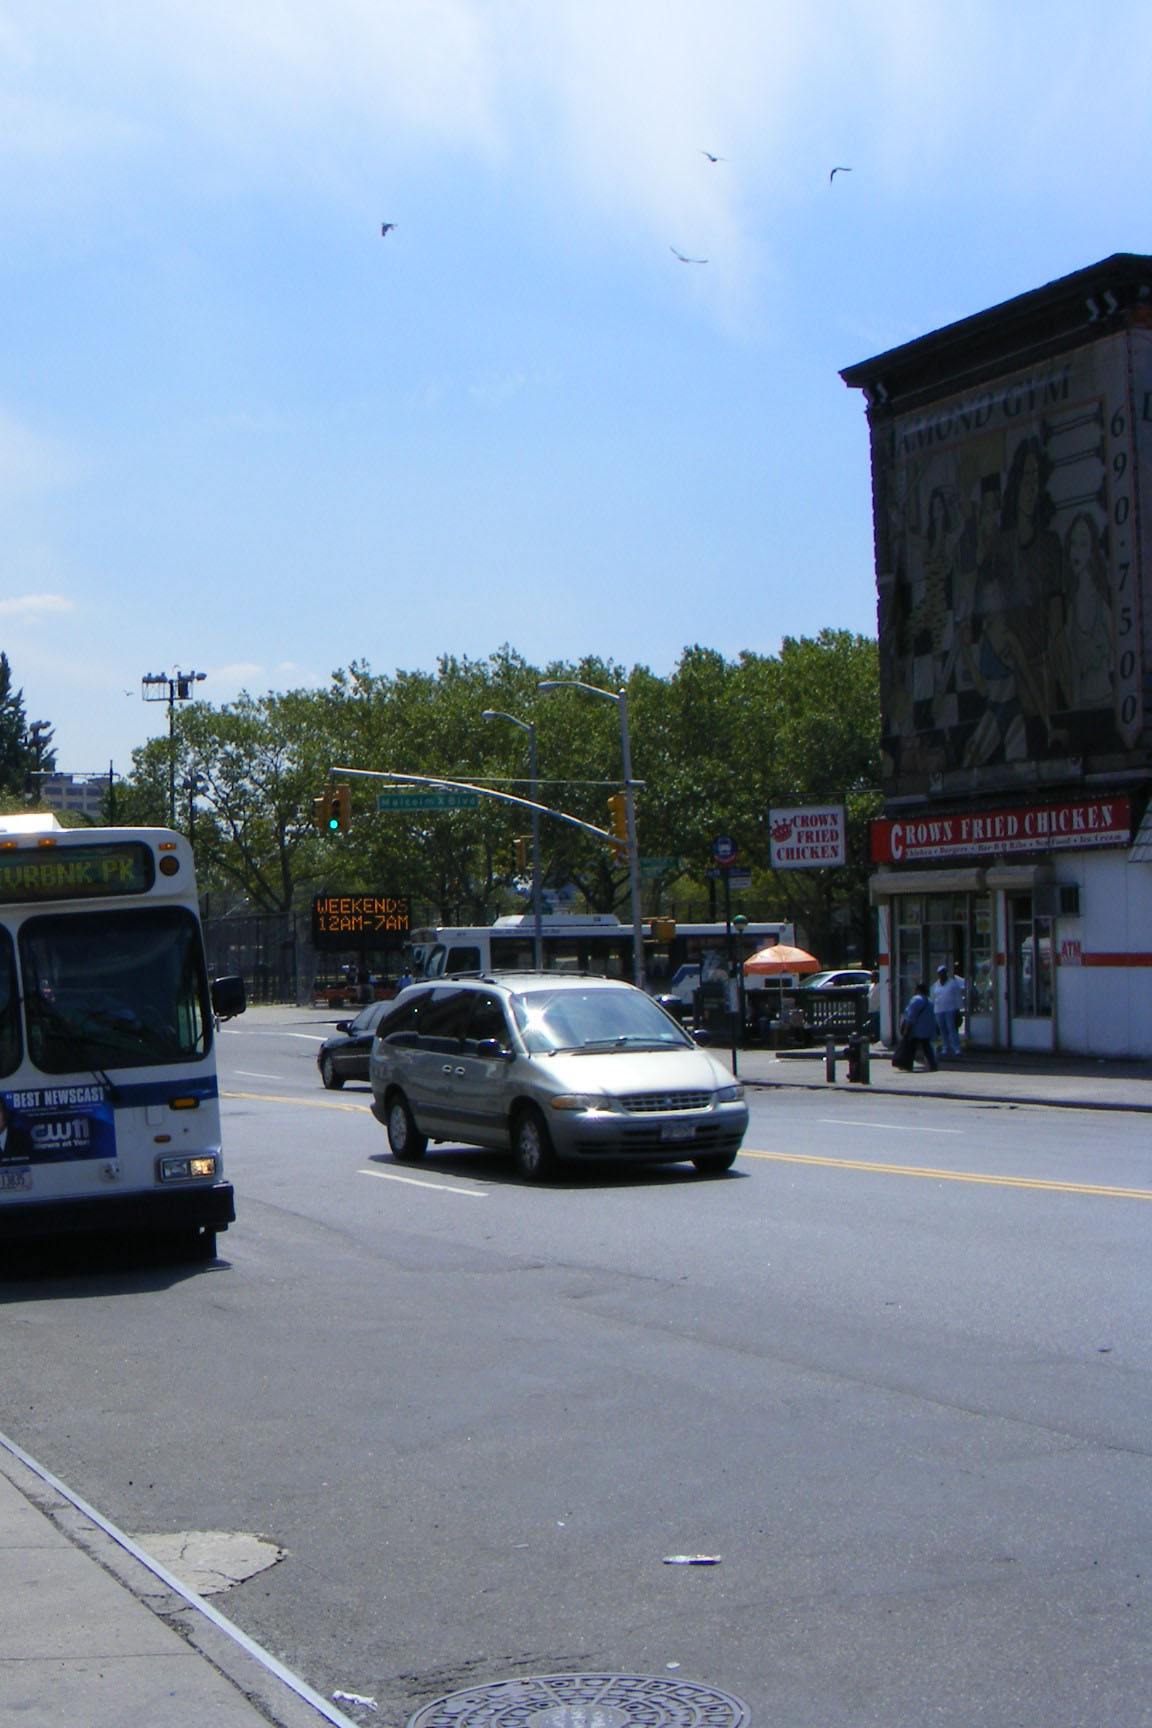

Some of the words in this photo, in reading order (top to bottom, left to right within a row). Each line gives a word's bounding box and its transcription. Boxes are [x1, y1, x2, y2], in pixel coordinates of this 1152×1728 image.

[792, 813, 839, 828] CROWN
[797, 829, 839, 843] FRIED
[890, 820, 953, 860] CROWN
[961, 814, 1019, 839] FRIED
[1024, 804, 1114, 835] CHICKEN
[776, 845, 839, 861] CHICKEN
[102, 857, 136, 882] PK
[317, 898, 409, 914] WEEKENDS
[319, 914, 409, 932] 12AM-7AM
